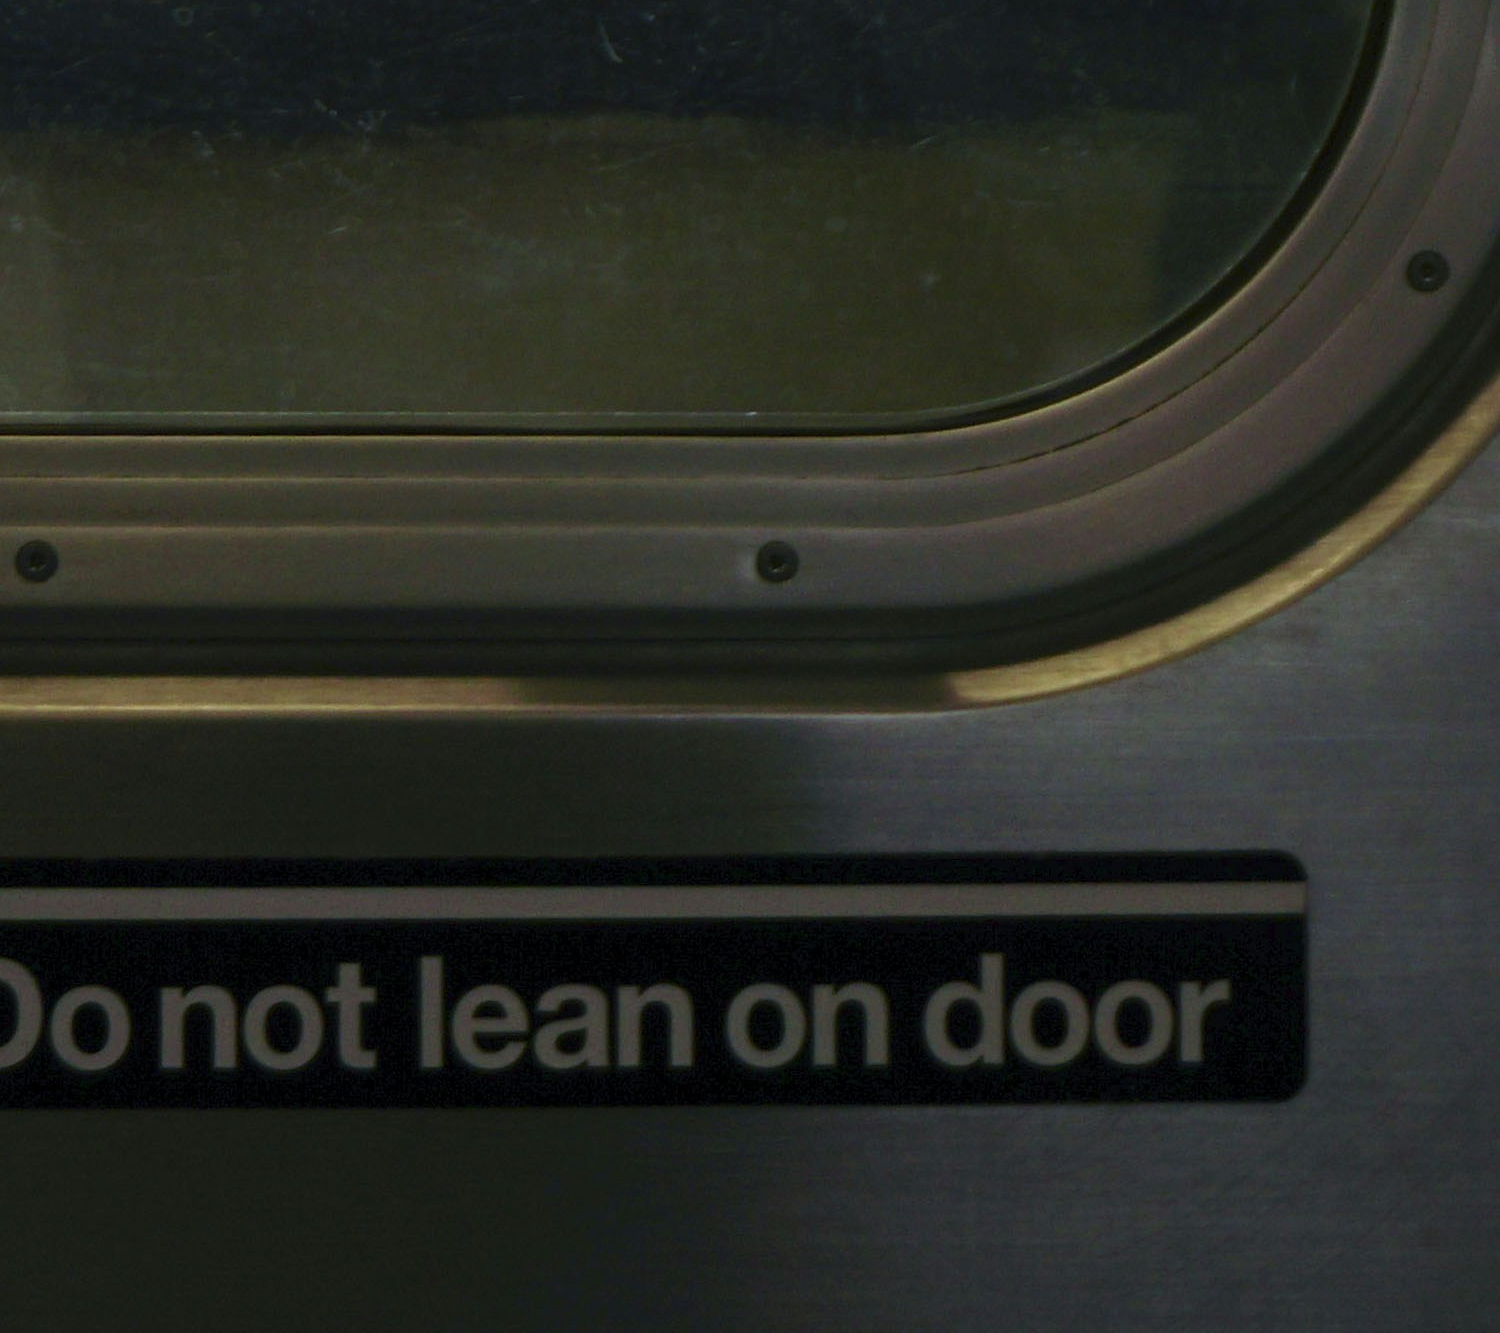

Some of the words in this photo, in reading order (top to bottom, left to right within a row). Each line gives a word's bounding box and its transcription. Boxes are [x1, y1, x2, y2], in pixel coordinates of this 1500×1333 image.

[158, 961, 378, 1073] not
[418, 954, 695, 1073] lean
[724, 981, 891, 1071] on
[921, 951, 1232, 1069] door
